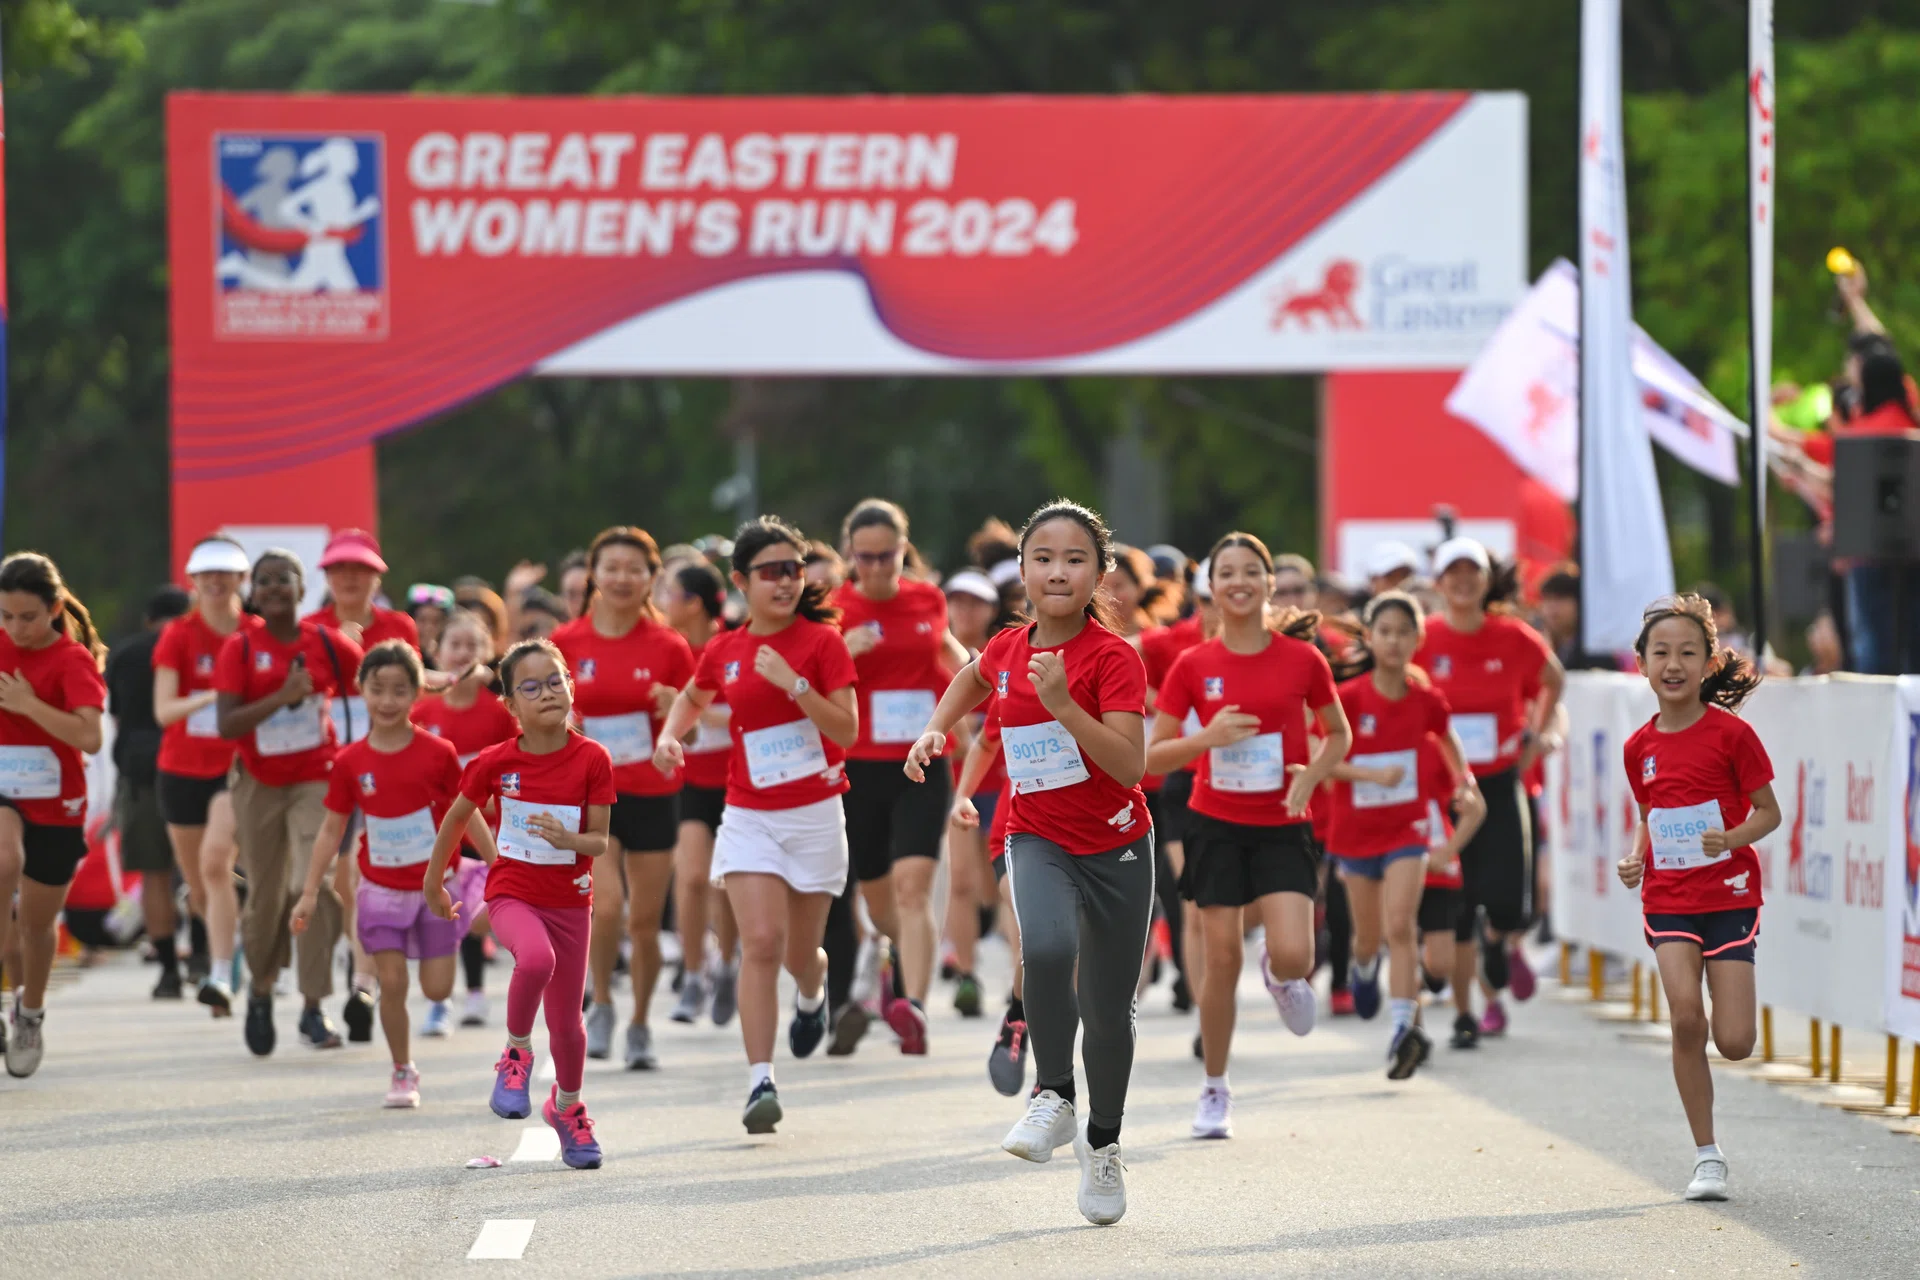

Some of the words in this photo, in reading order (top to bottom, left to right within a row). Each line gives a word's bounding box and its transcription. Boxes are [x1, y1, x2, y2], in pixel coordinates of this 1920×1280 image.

[408, 132, 636, 190] GREAT
[640, 132, 957, 190] EASTERN
[411, 198, 741, 256] WOMEN'S
[749, 200, 897, 255] RUN
[903, 198, 1079, 256] 2024
[1371, 254, 1477, 294] Great
[1012, 738, 1060, 760] 90173
[1660, 820, 1707, 839] 91569
